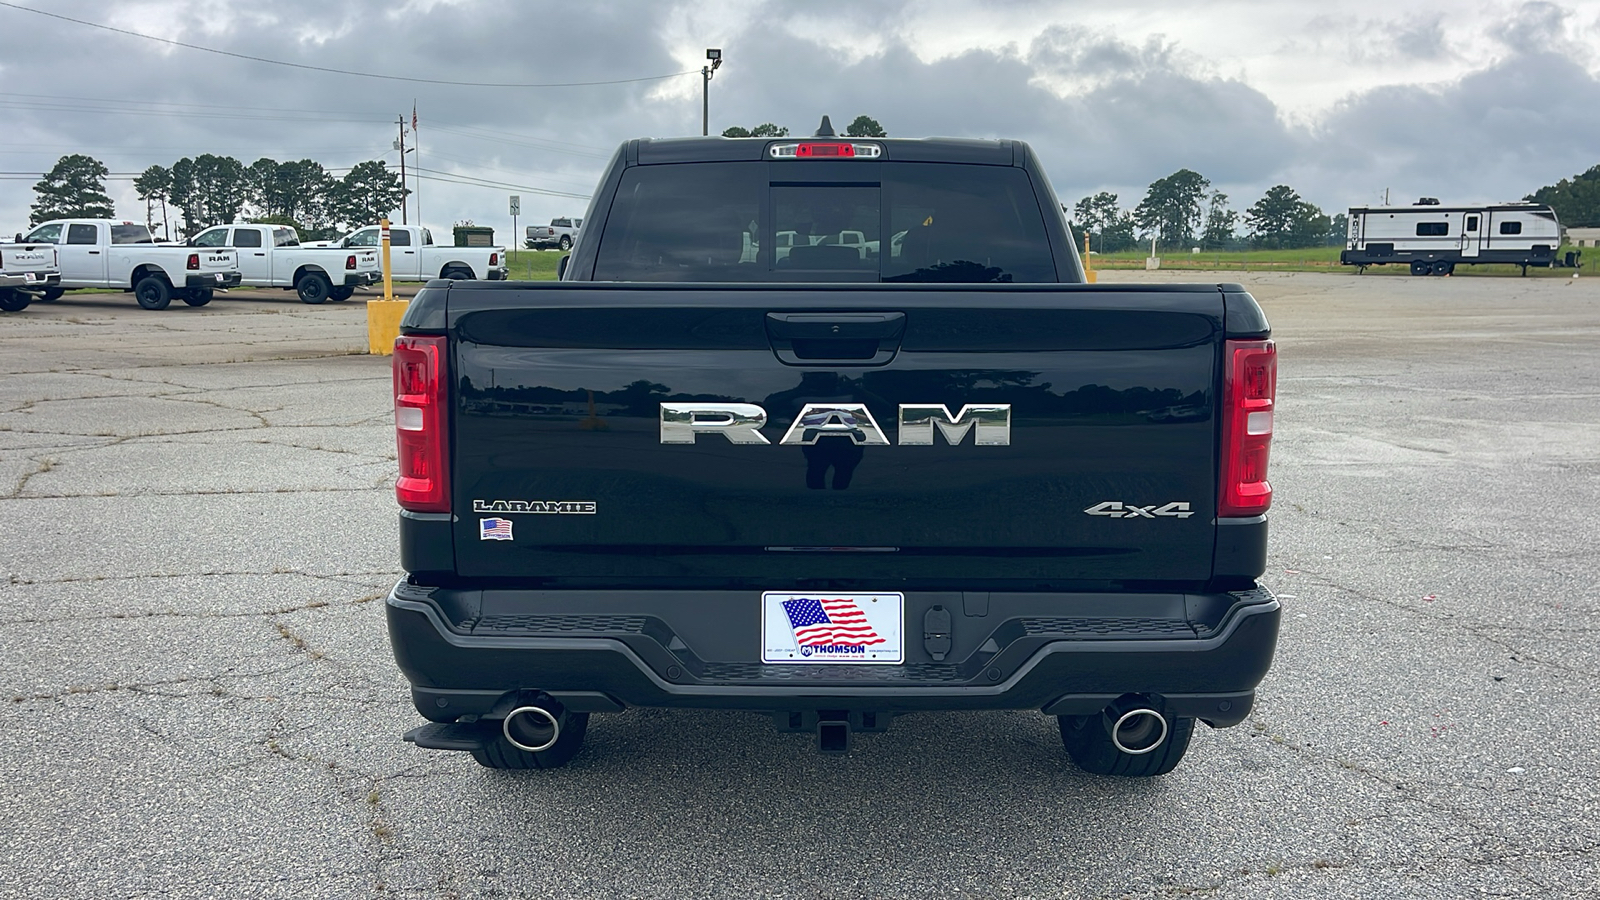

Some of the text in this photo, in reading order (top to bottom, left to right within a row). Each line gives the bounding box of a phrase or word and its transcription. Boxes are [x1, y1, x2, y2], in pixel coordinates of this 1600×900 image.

[659, 402, 1012, 446] RAM
[473, 499, 597, 514] LARAMIE
[1084, 501, 1195, 519] 4x4
[814, 645, 865, 654] THOMSON
